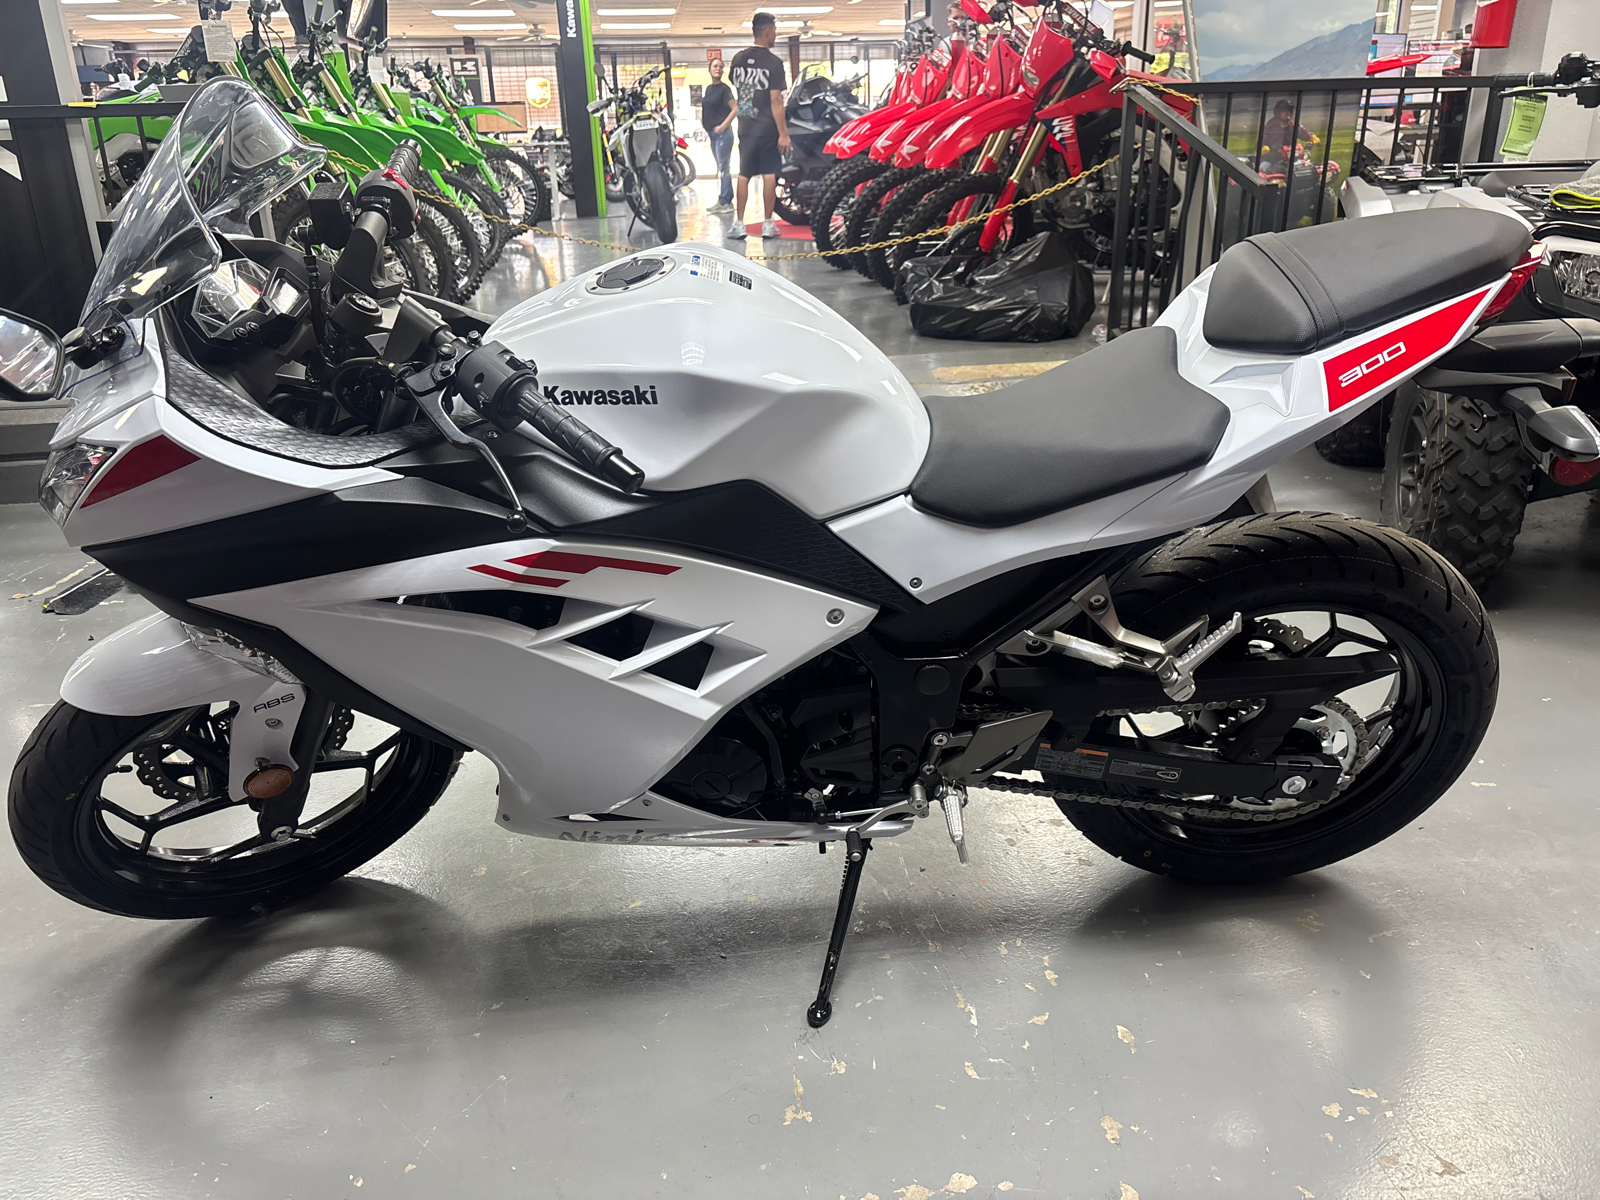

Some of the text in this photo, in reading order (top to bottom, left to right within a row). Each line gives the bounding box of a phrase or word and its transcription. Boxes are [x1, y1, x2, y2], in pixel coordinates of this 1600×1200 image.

[1338, 341, 1407, 388] 300
[543, 385, 659, 406] Kawasaki
[253, 692, 296, 714] ABS
